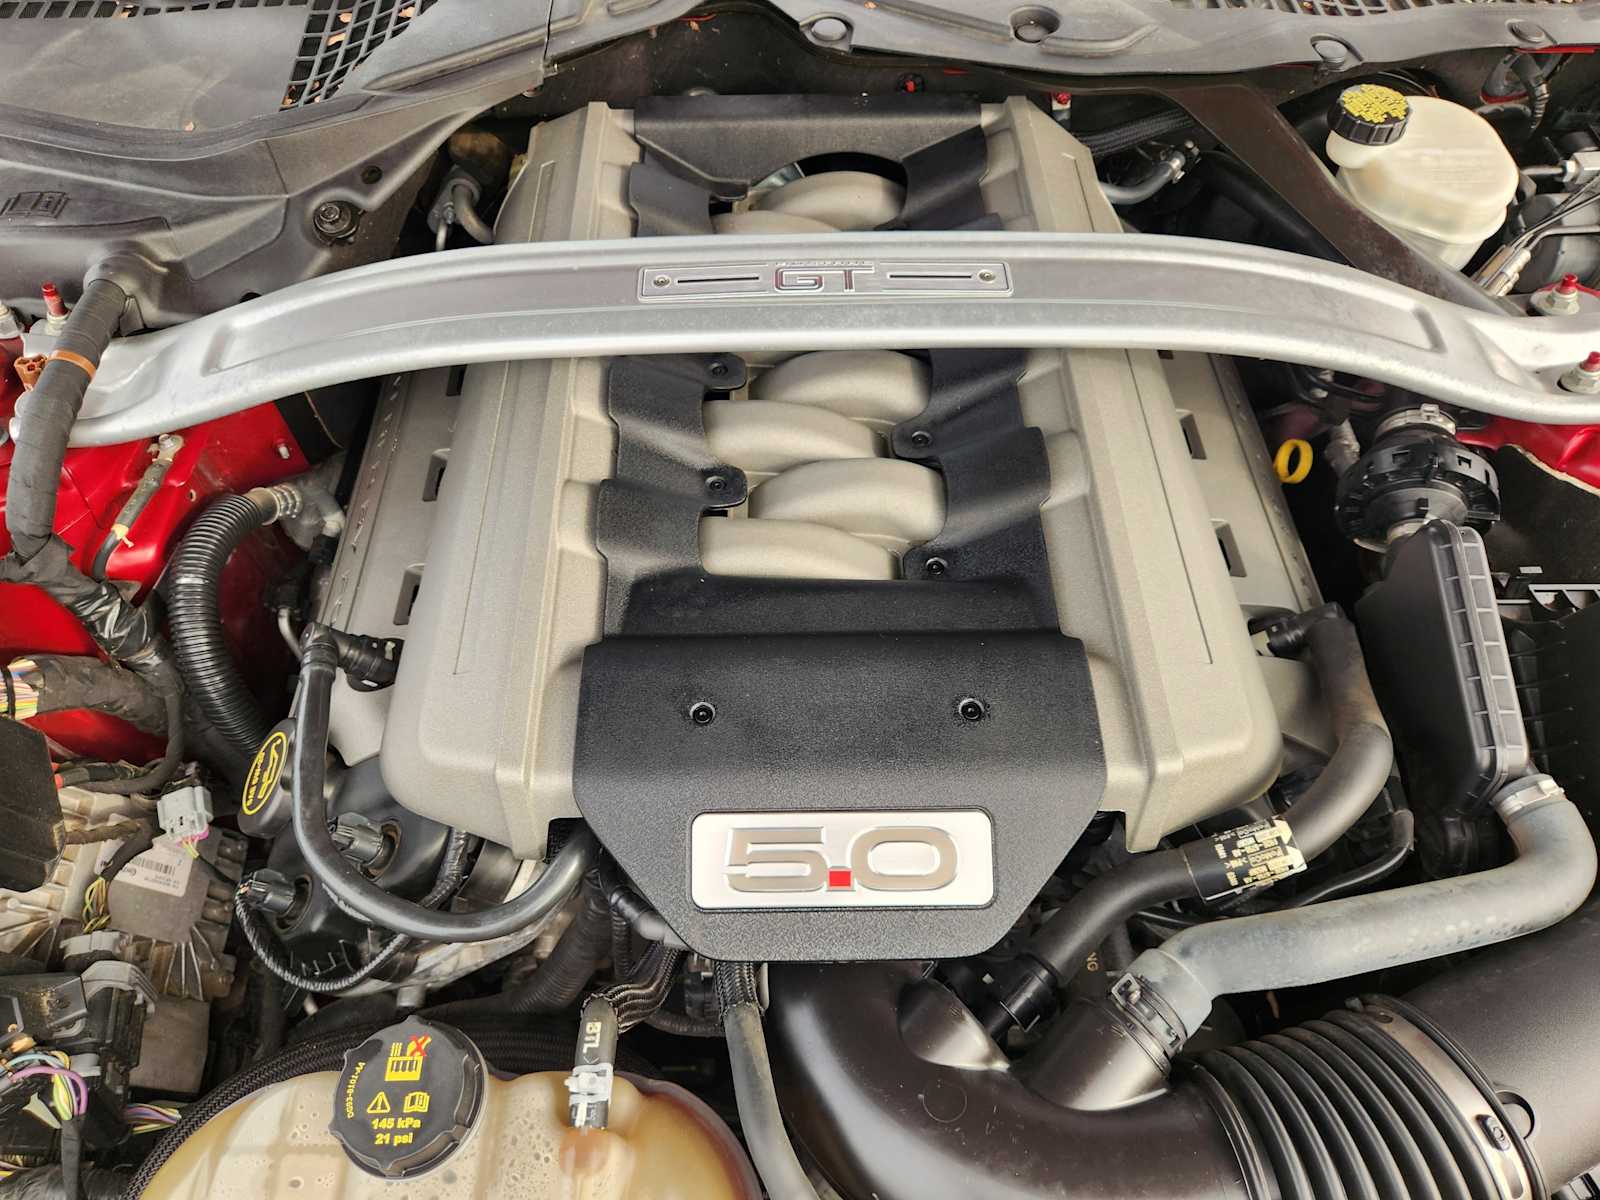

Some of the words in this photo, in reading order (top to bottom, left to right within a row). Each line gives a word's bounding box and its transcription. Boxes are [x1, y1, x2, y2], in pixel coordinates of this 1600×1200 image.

[774, 265, 875, 292] GT
[725, 825, 959, 893] 5.0
[371, 1117, 395, 1130] 145
[396, 1116, 421, 1129] kPa
[374, 1132, 391, 1145] 21
[392, 1131, 414, 1147] psi
